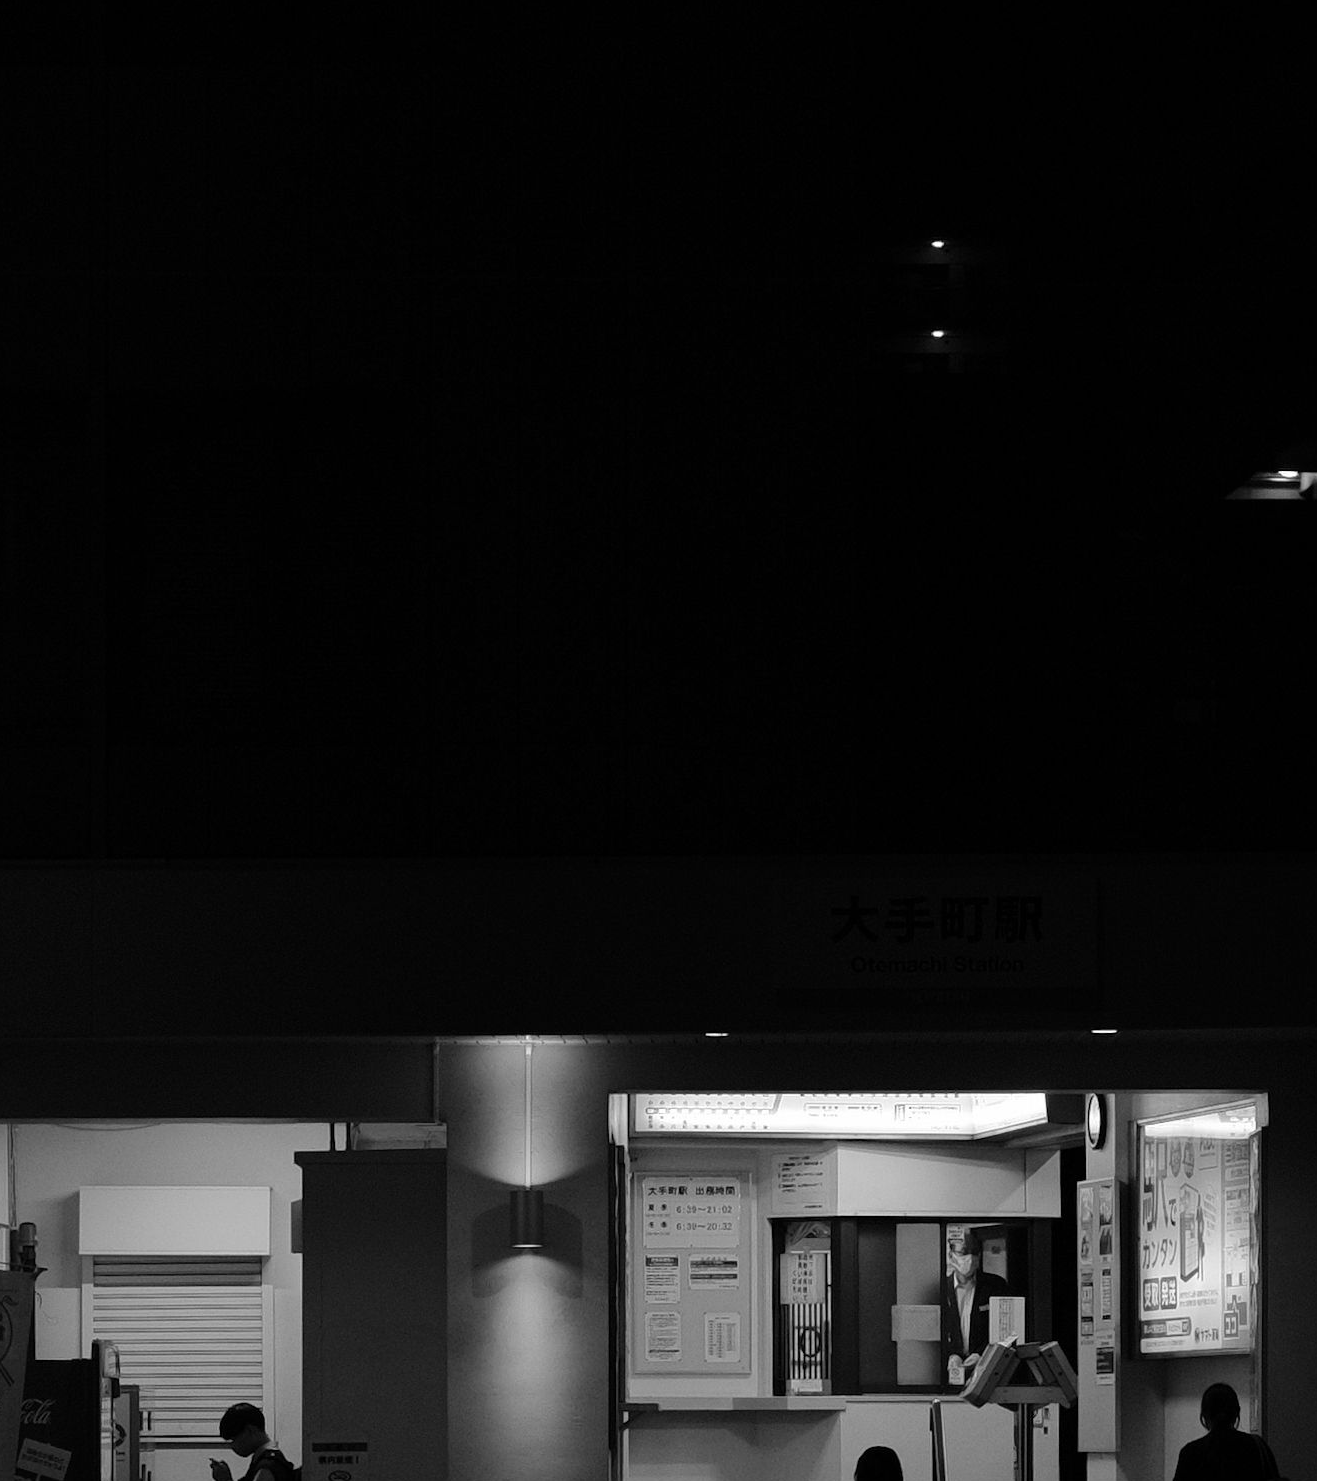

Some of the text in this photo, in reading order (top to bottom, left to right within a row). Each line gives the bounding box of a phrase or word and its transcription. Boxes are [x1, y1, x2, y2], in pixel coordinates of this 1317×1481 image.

[831, 895, 1043, 943] 大手町駅
[851, 955, 1024, 974] Otemachi Station
